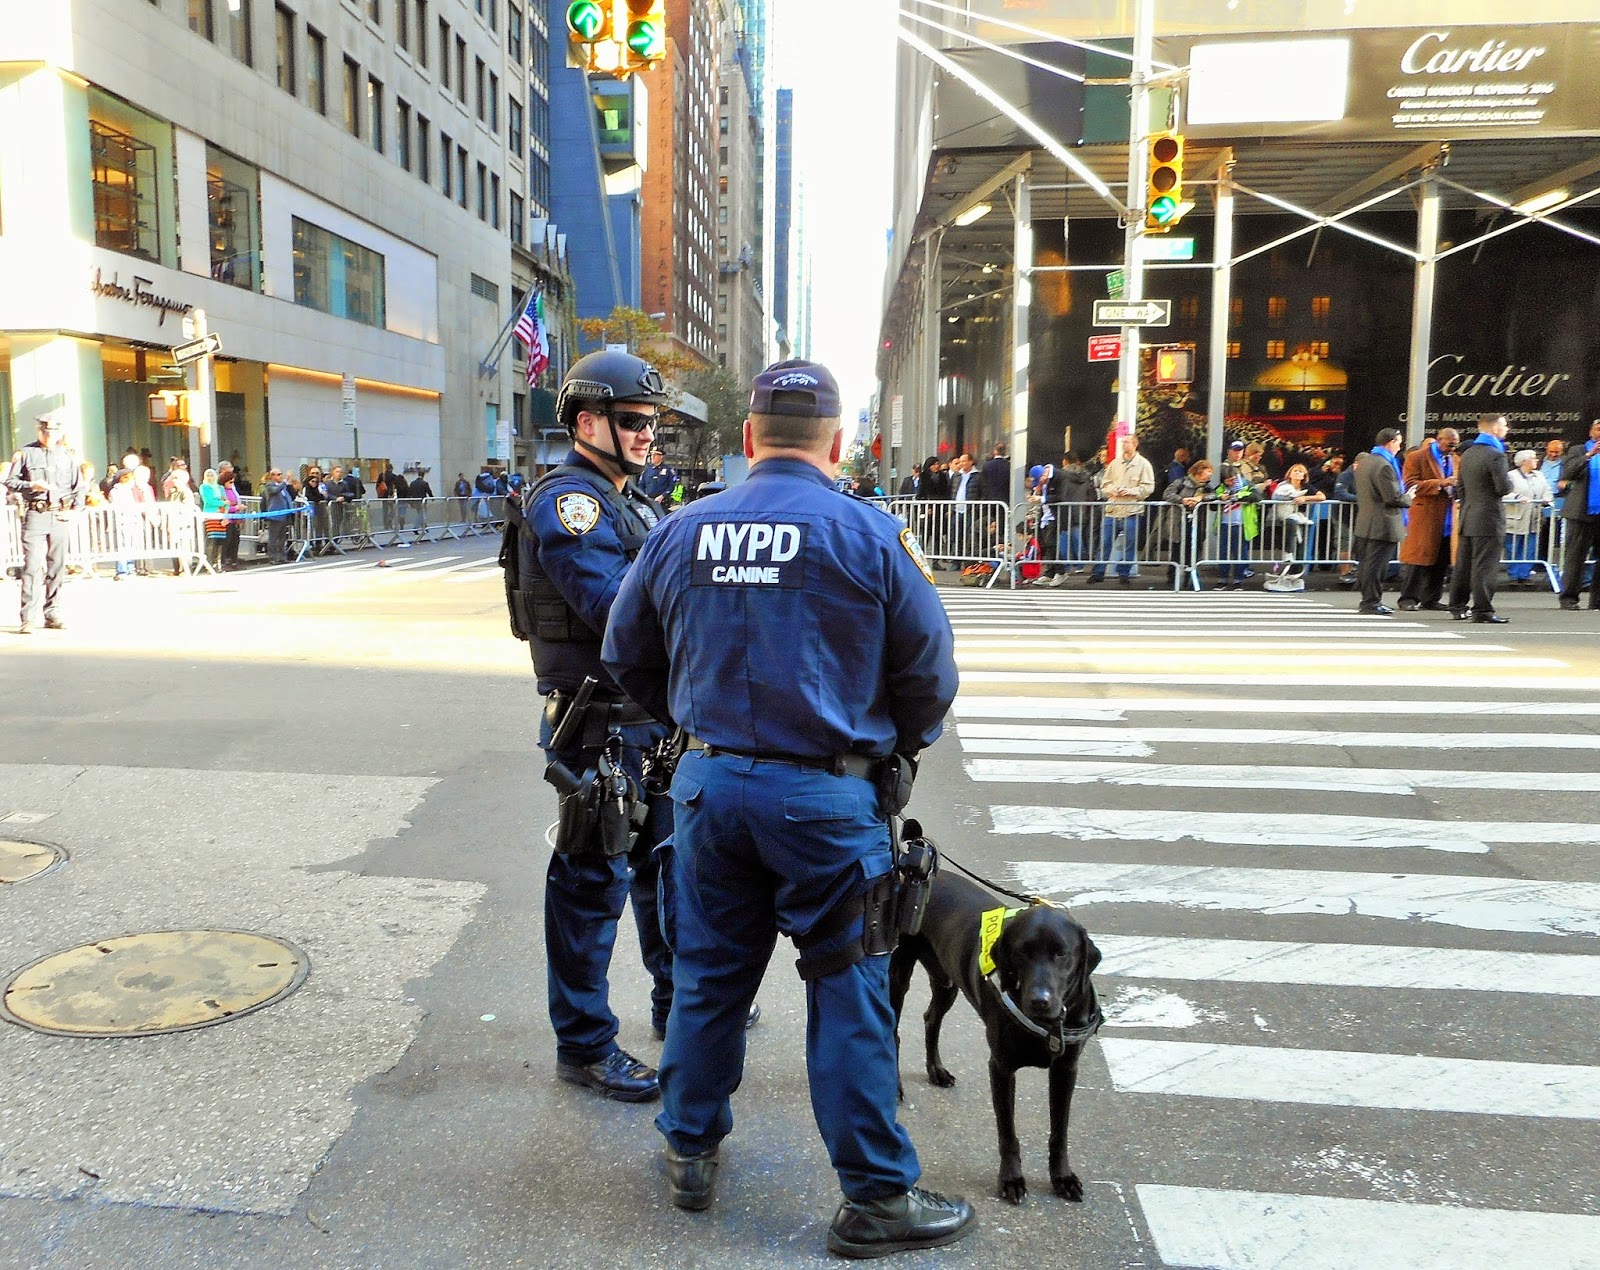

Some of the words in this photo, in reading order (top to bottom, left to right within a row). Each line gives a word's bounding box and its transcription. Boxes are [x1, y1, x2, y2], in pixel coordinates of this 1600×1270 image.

[1400, 32, 1548, 74] Cartier
[1105, 308, 1126, 318] ONE
[1135, 308, 1158, 318] WAY
[1427, 354, 1570, 397] Cartier
[1442, 412, 1483, 422] MANSIO
[1555, 411, 1581, 422] 2016
[697, 523, 801, 562] NYPD
[712, 565, 780, 584] CANINE
[986, 915, 999, 963] POLI
